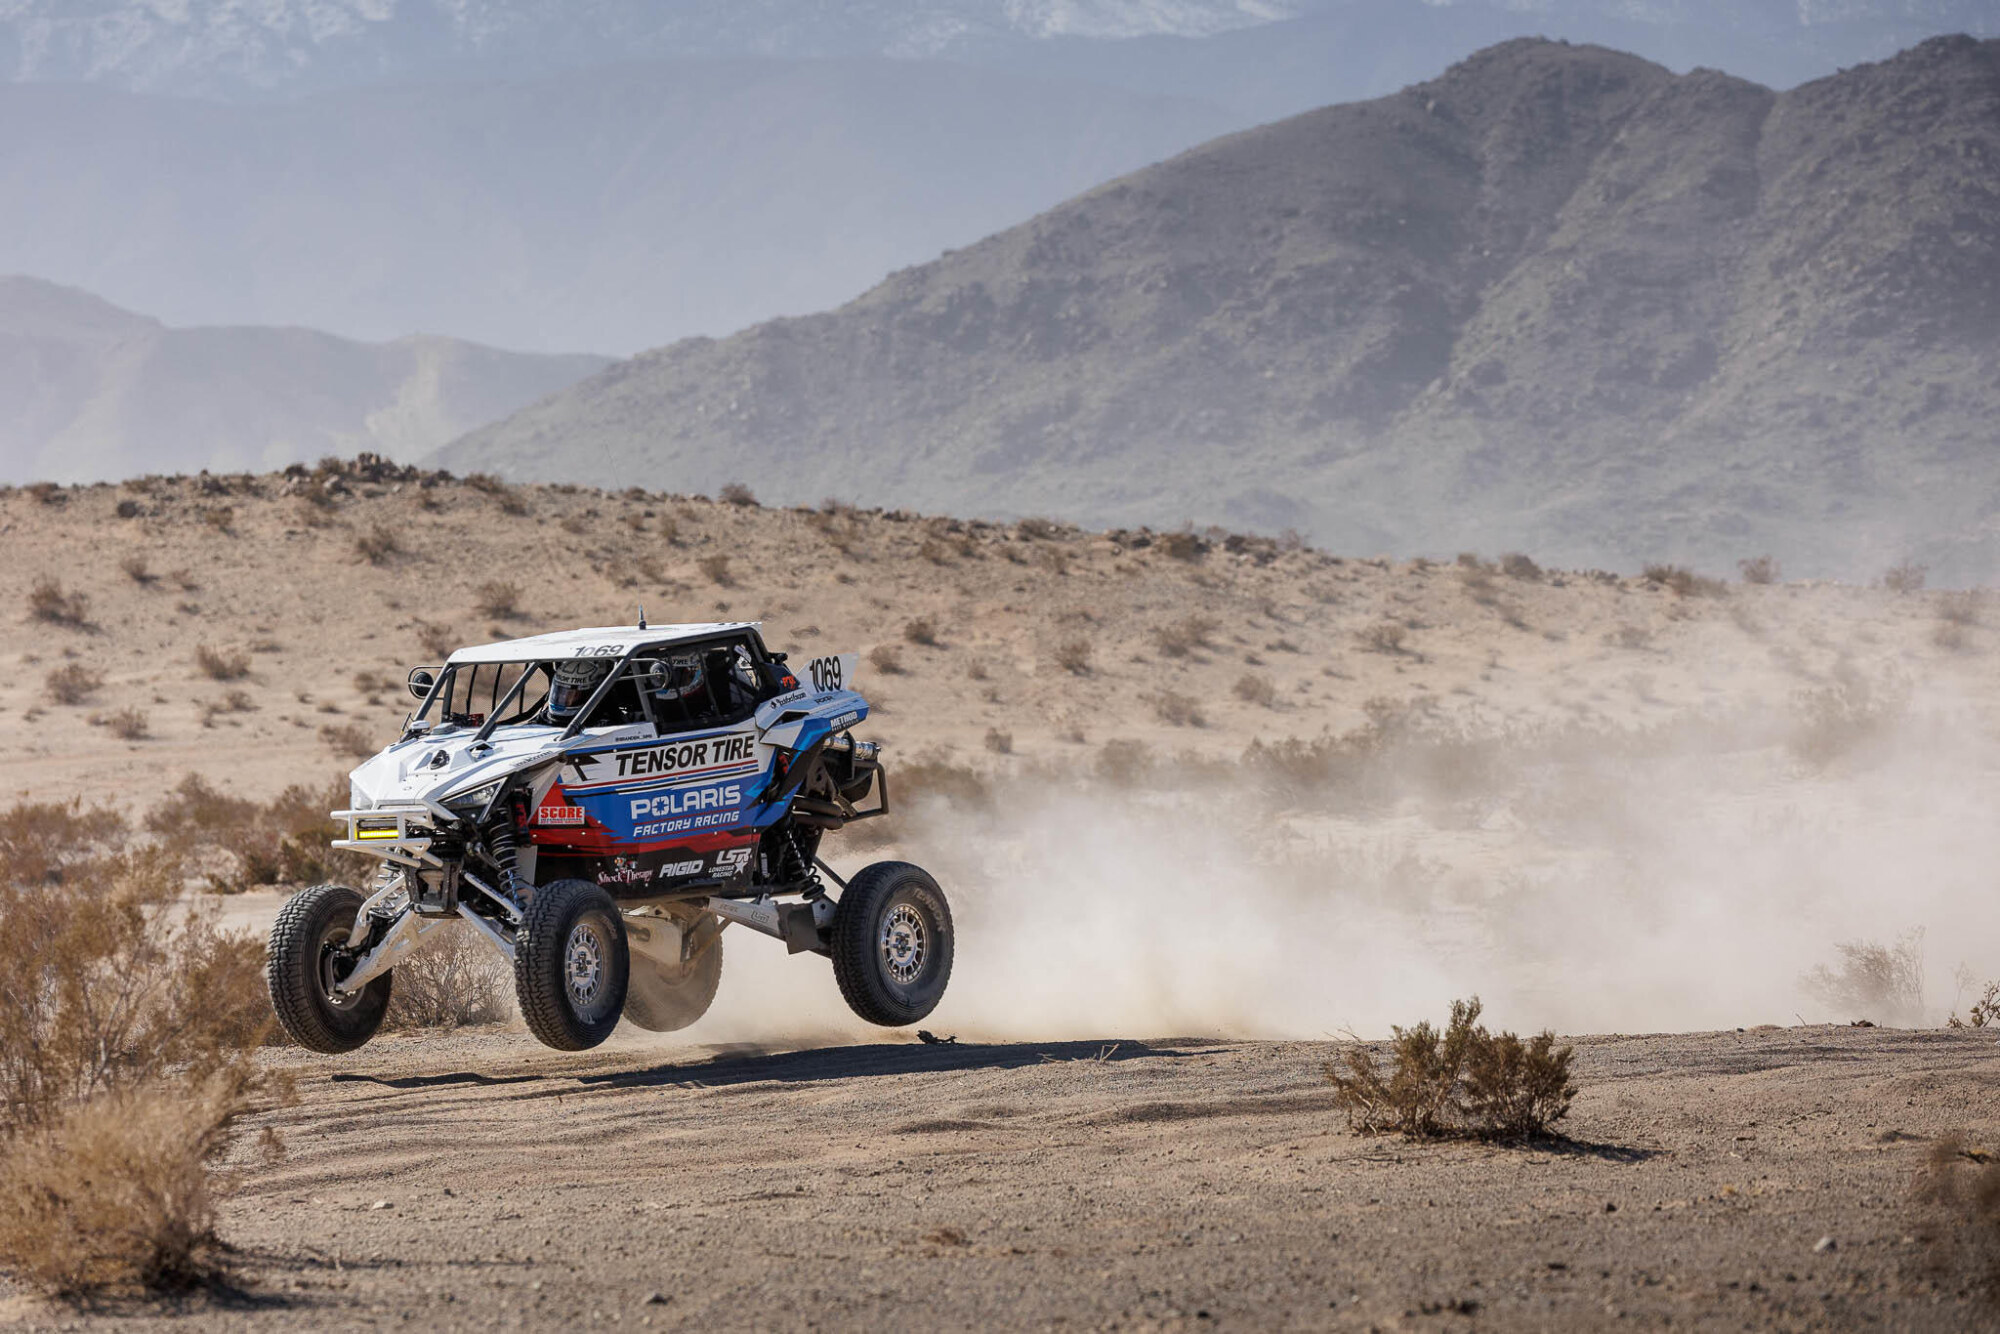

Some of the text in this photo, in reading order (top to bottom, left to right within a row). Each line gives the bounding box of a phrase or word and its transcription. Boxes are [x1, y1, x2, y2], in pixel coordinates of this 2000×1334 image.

[575, 644, 624, 657] 1069
[809, 655, 842, 693] 1069
[830, 711, 858, 728] METHOD
[615, 735, 755, 777] TENSOR TIRE
[630, 784, 741, 820] POLARIS
[540, 807, 583, 819] SCORE
[633, 811, 740, 837] FACTORY RACING
[716, 848, 752, 865] LSR
[597, 867, 653, 885] Shock Therapy
[659, 859, 704, 878] RIGID
